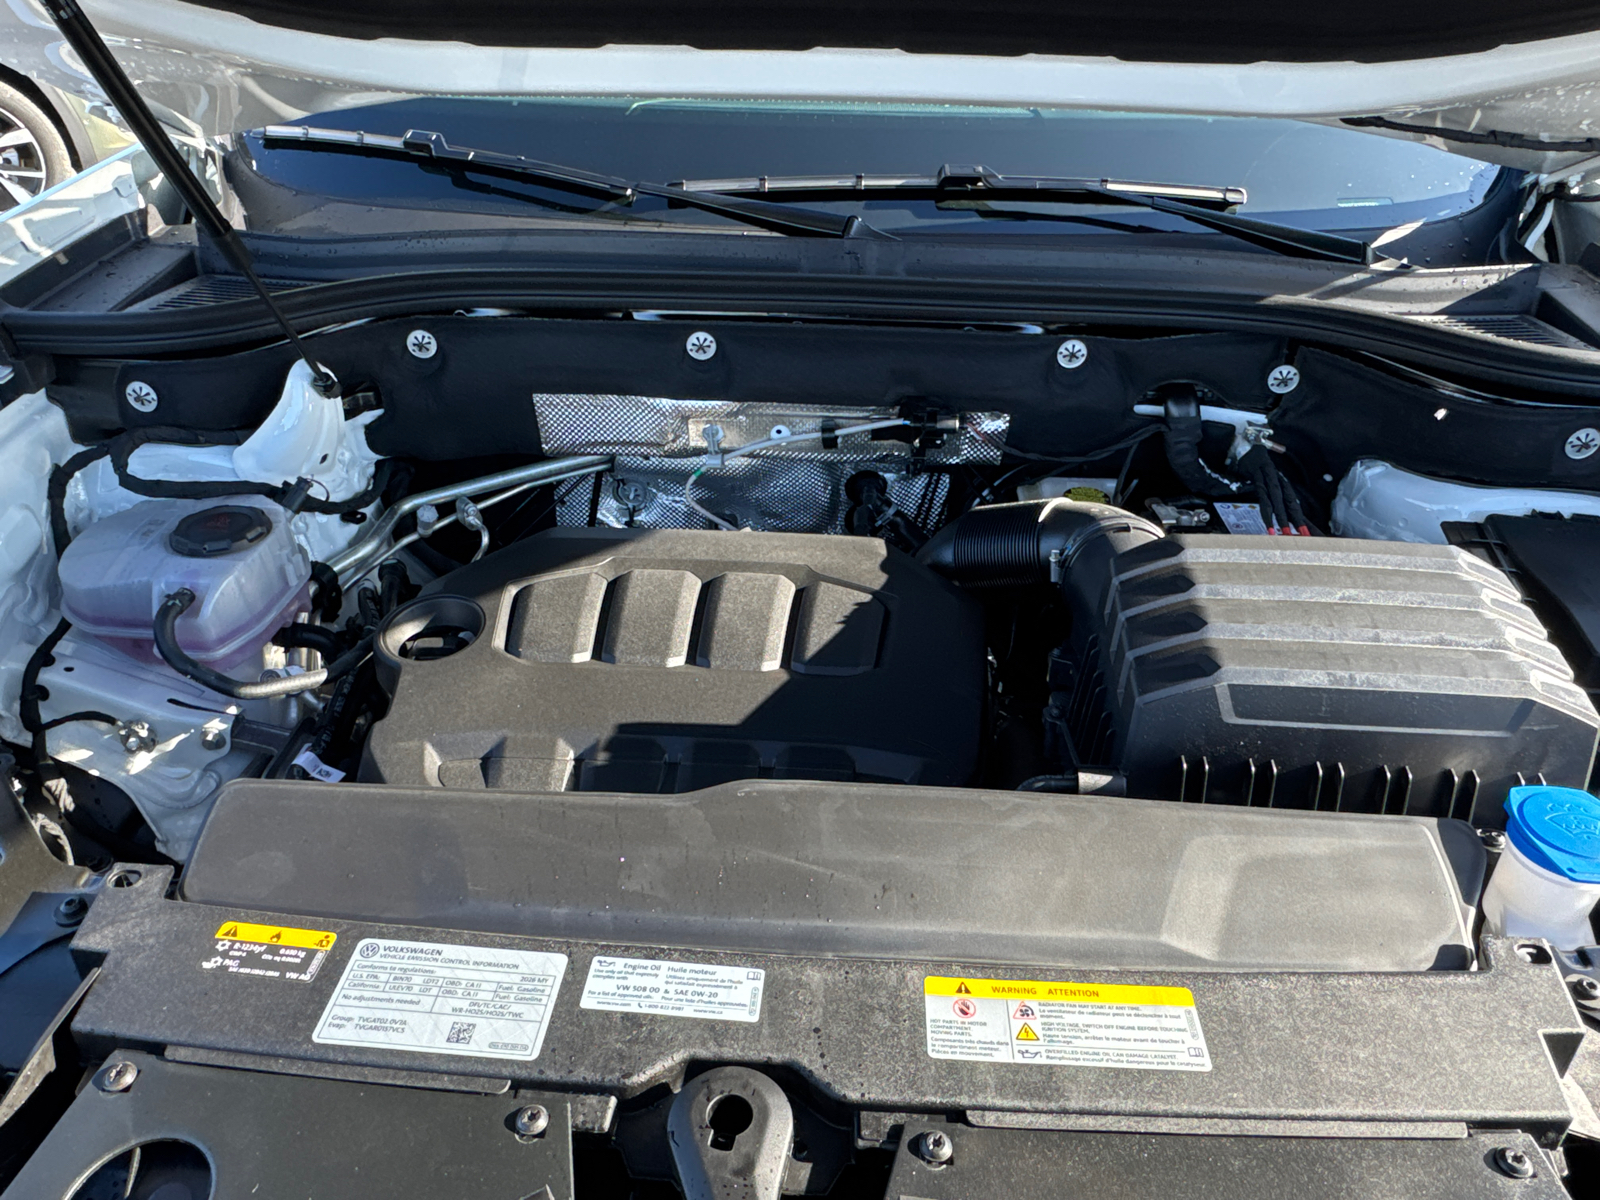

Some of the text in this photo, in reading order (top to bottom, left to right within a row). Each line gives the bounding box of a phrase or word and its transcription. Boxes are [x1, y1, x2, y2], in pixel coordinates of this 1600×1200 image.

[234, 943, 267, 953] R-1234yf
[383, 945, 443, 956] VOLKSWAGEN
[407, 955, 439, 963] EMISSION
[441, 958, 470, 966] CONTROL
[473, 961, 519, 969] INFORMATION
[357, 963, 388, 971] Conforms
[691, 990, 718, 998] 0W-20
[991, 986, 1099, 997] WARNING ATTENTION
[353, 995, 394, 1003] adjustments
[332, 1014, 355, 1022] Group:
